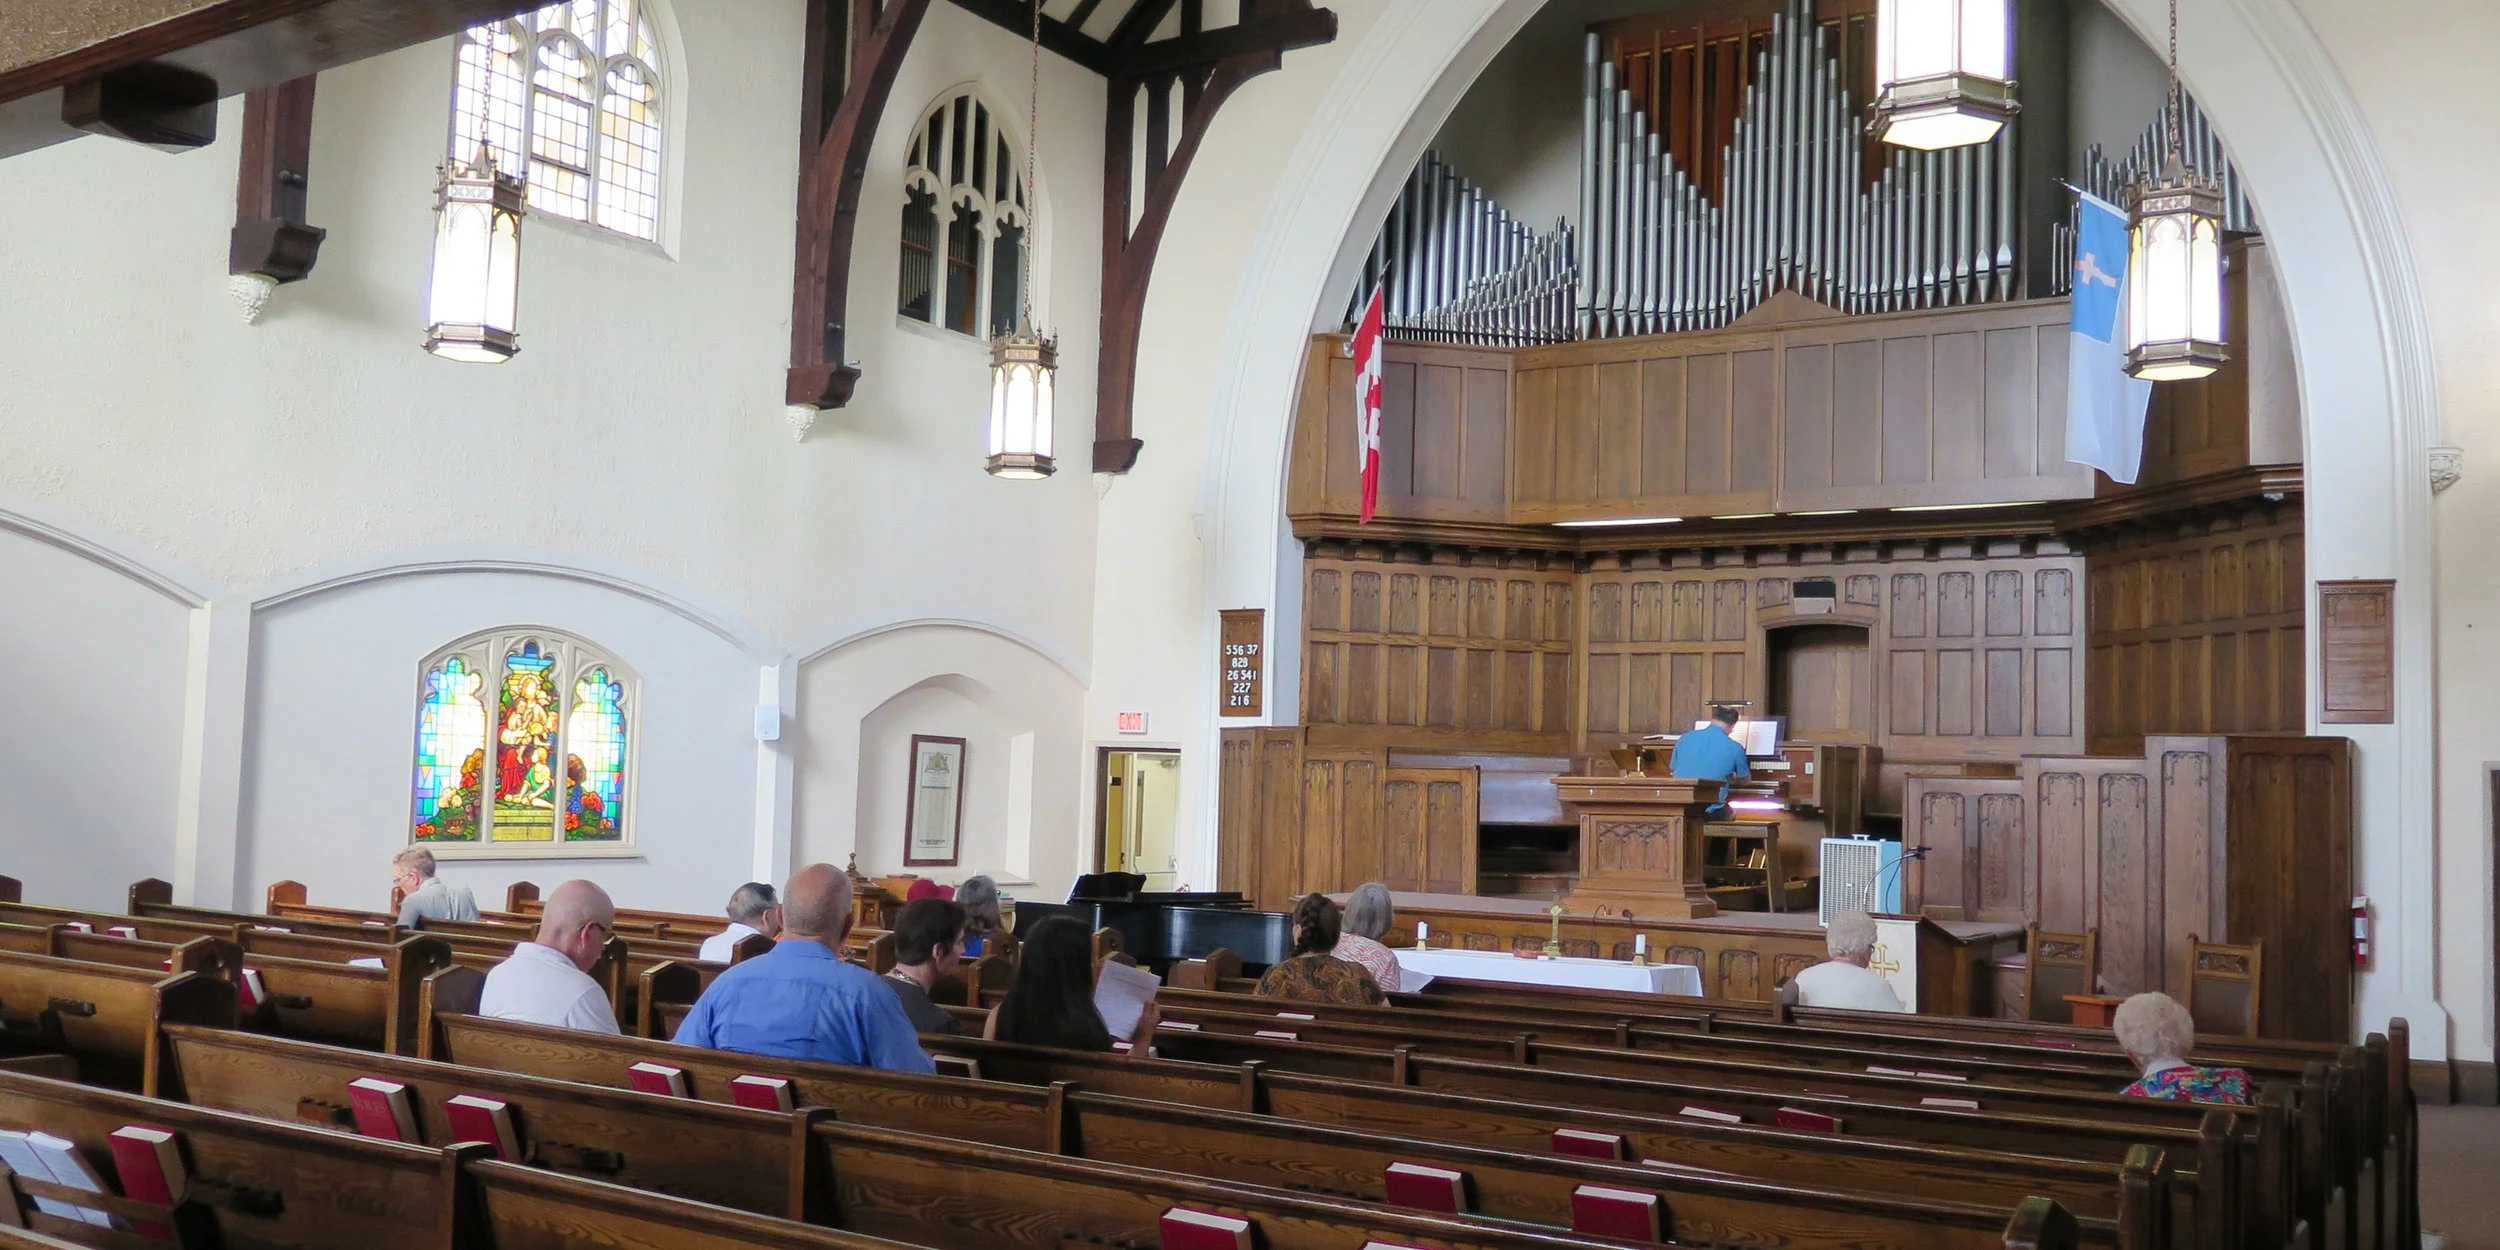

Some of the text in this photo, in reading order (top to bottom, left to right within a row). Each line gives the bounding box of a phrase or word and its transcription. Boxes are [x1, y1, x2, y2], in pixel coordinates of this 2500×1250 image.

[1226, 644, 1258, 655] 556 37
[1227, 669, 1256, 681] 26 541
[1233, 682, 1251, 693] 227
[1230, 695, 1250, 705] 216
[1119, 712, 1142, 730] EXIT
